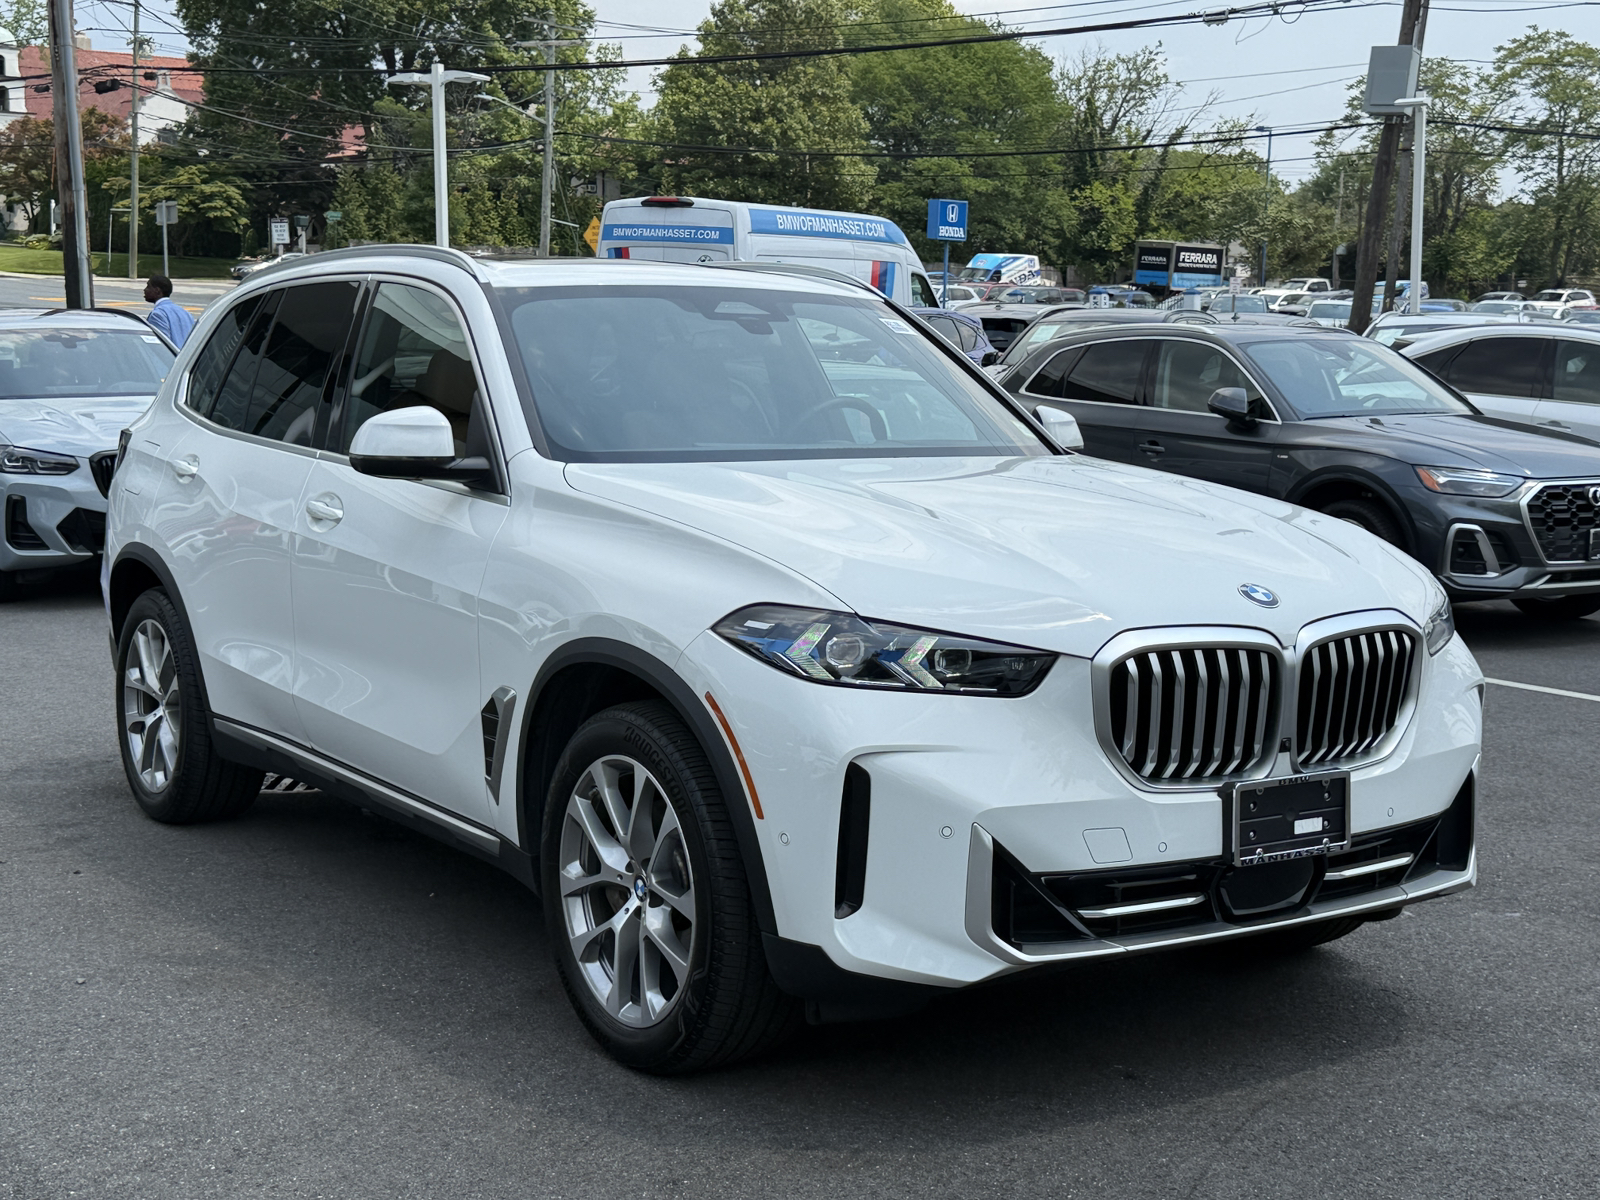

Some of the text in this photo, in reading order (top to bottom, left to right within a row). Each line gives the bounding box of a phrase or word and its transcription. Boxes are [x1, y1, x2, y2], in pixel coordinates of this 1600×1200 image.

[775, 214, 885, 238] BMWOFMANHASSET.COM
[938, 226, 965, 238] HONDA
[613, 227, 719, 239] BMWOFMANHASSET.COM
[1179, 252, 1218, 264] FERRARA
[623, 726, 691, 818] BRIDGESTONE
[1279, 775, 1310, 786] BMW
[1240, 844, 1345, 866] MANHASSET
